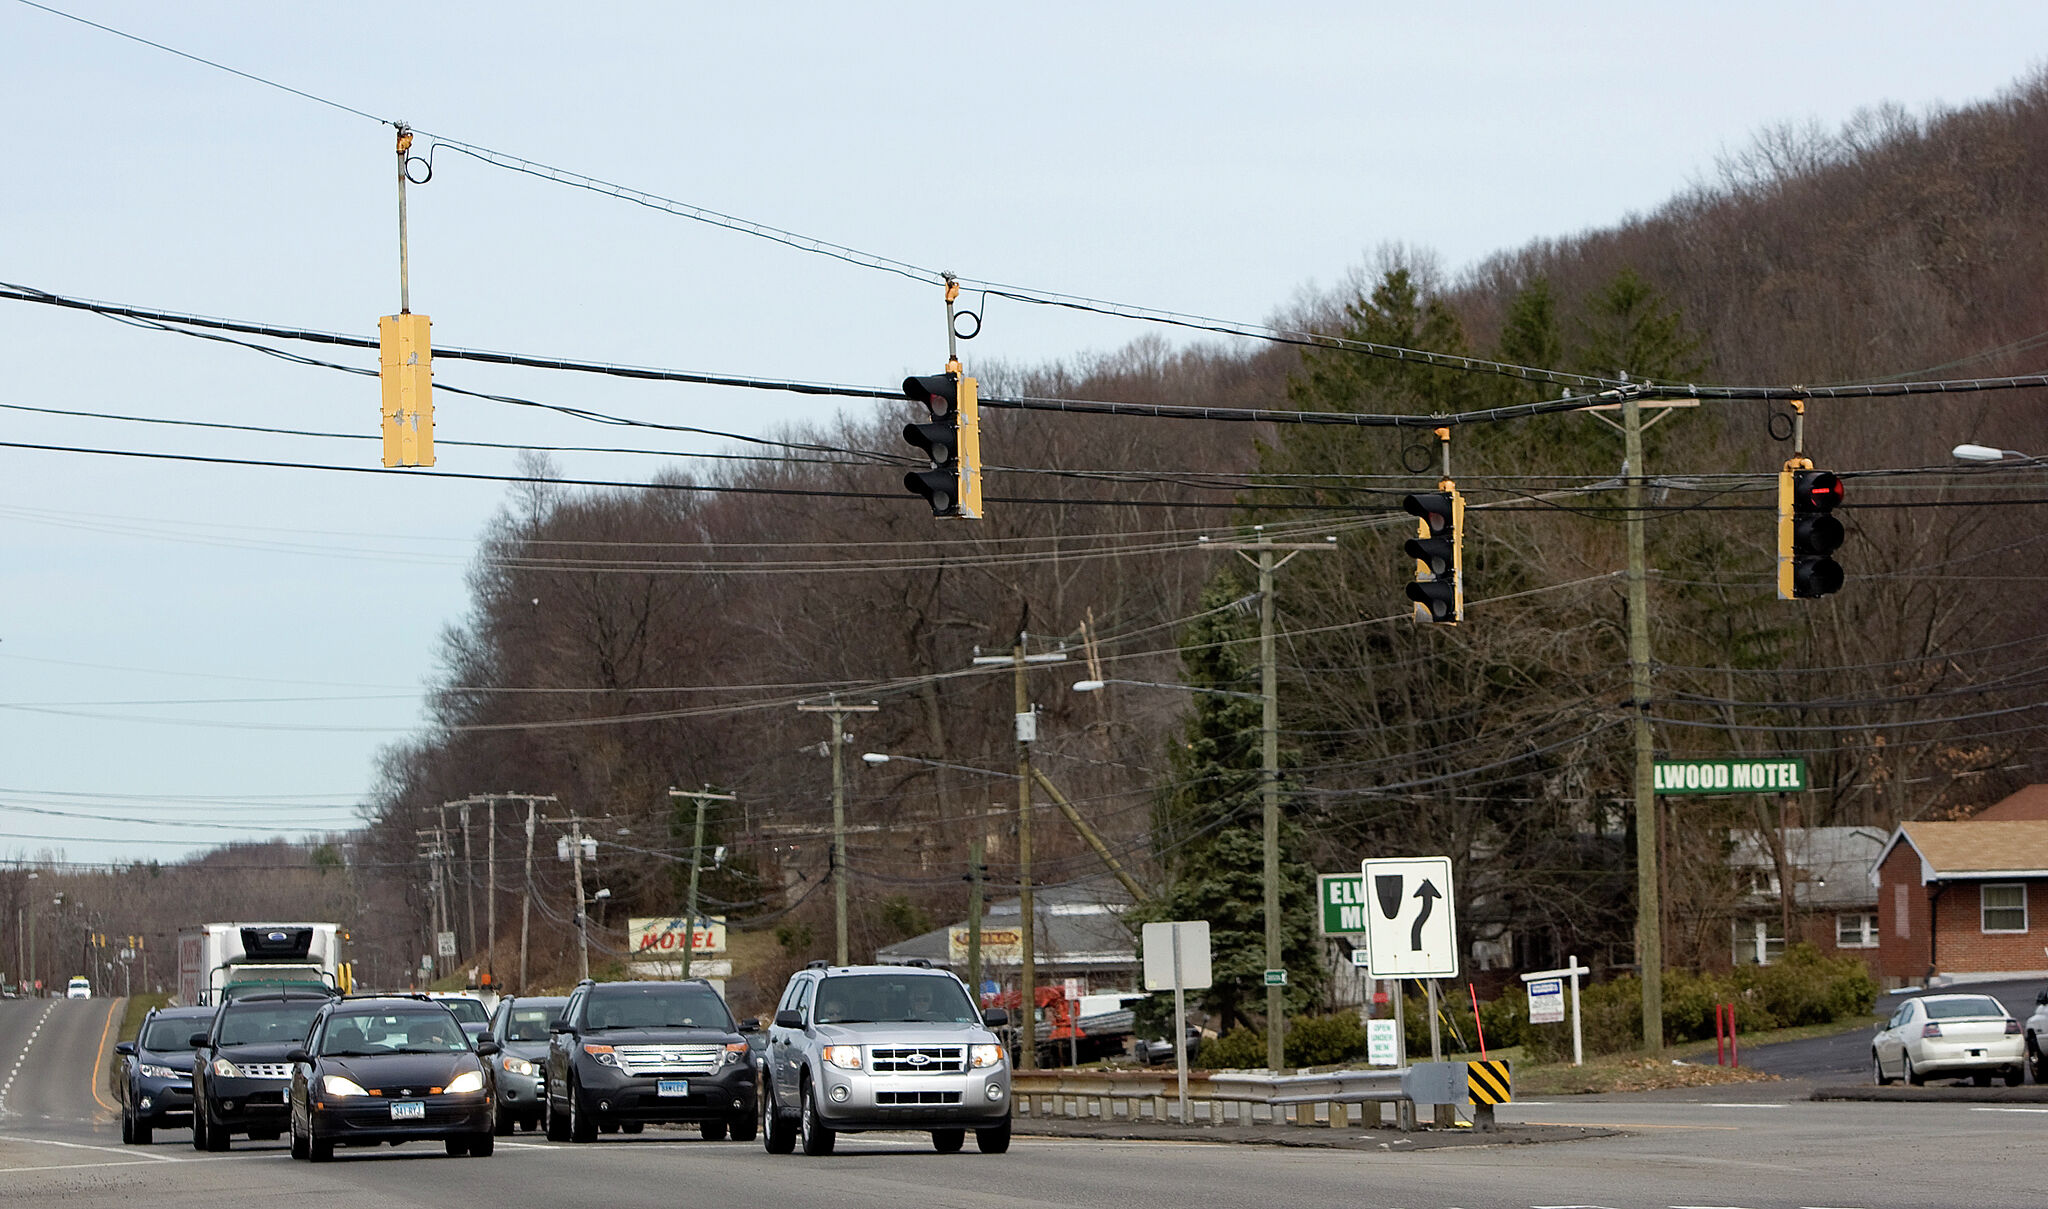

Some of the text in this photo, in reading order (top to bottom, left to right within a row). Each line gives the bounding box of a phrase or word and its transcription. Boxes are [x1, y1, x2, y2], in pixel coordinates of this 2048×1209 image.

[1654, 763, 1800, 789] LWOOD MOTEL
[640, 931, 716, 949] MOTEL
